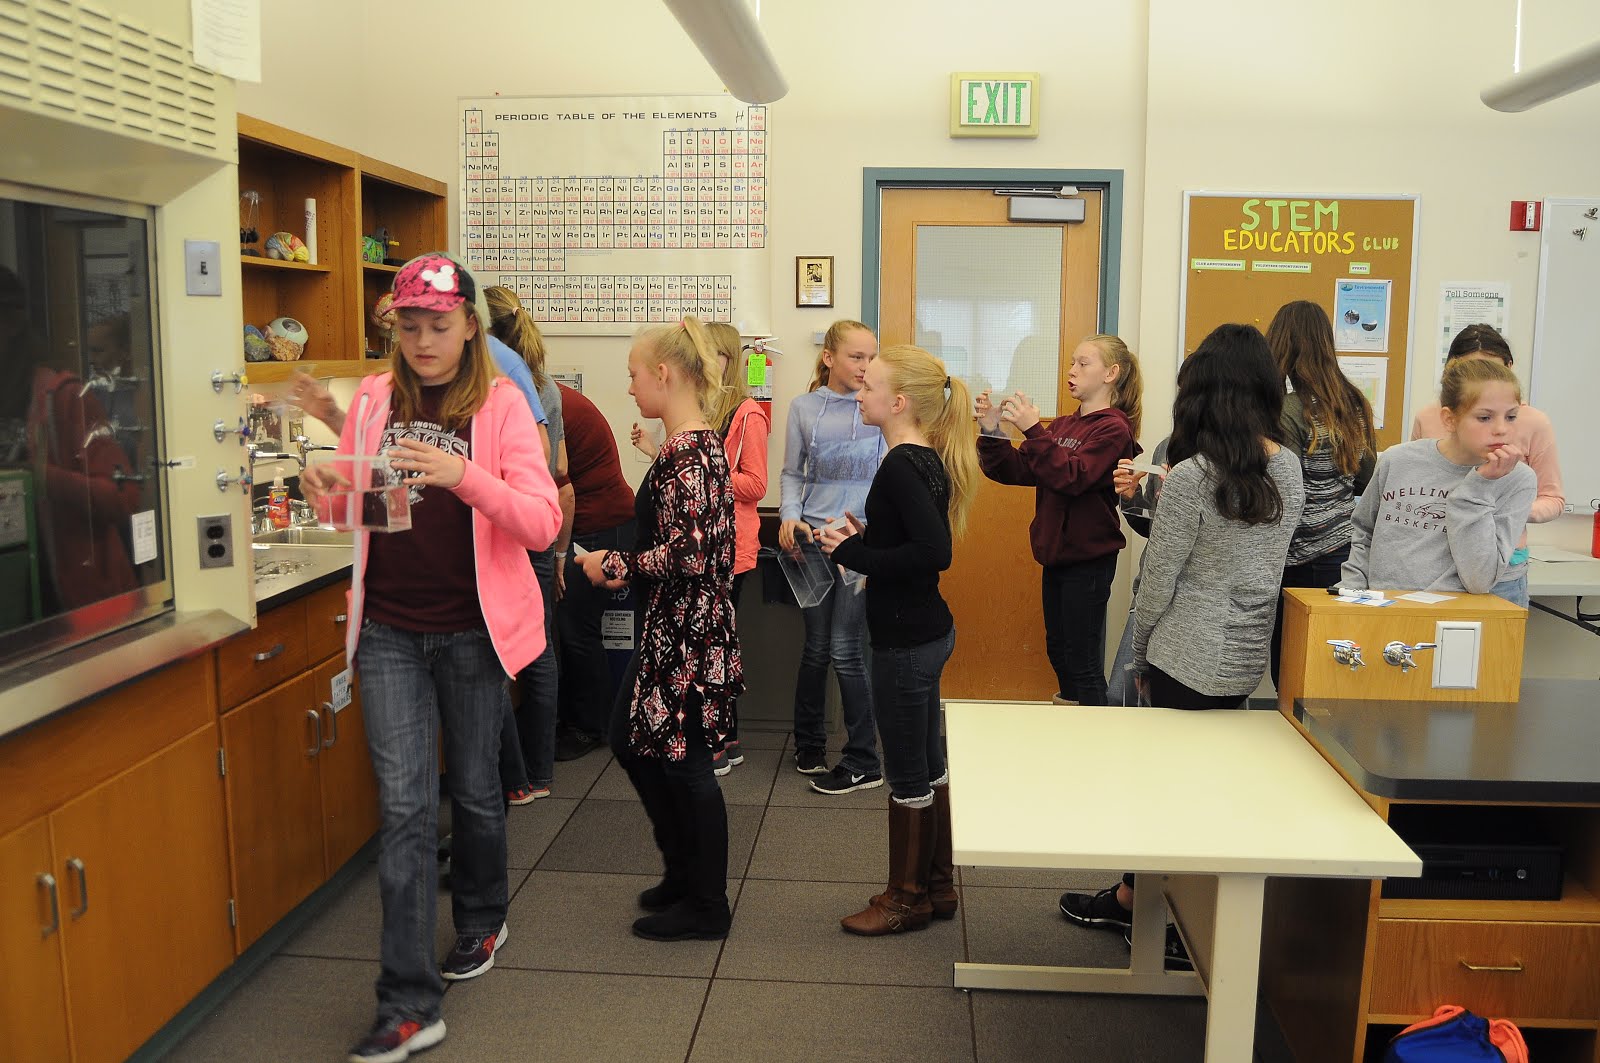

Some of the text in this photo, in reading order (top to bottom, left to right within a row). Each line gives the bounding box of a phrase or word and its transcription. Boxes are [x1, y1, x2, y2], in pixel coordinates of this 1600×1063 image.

[968, 83, 1027, 123] EXIT
[1241, 199, 1340, 232] STEM
[1223, 229, 1399, 255] EDUCATORS CLUB
[1383, 487, 1449, 501] WELLIN
